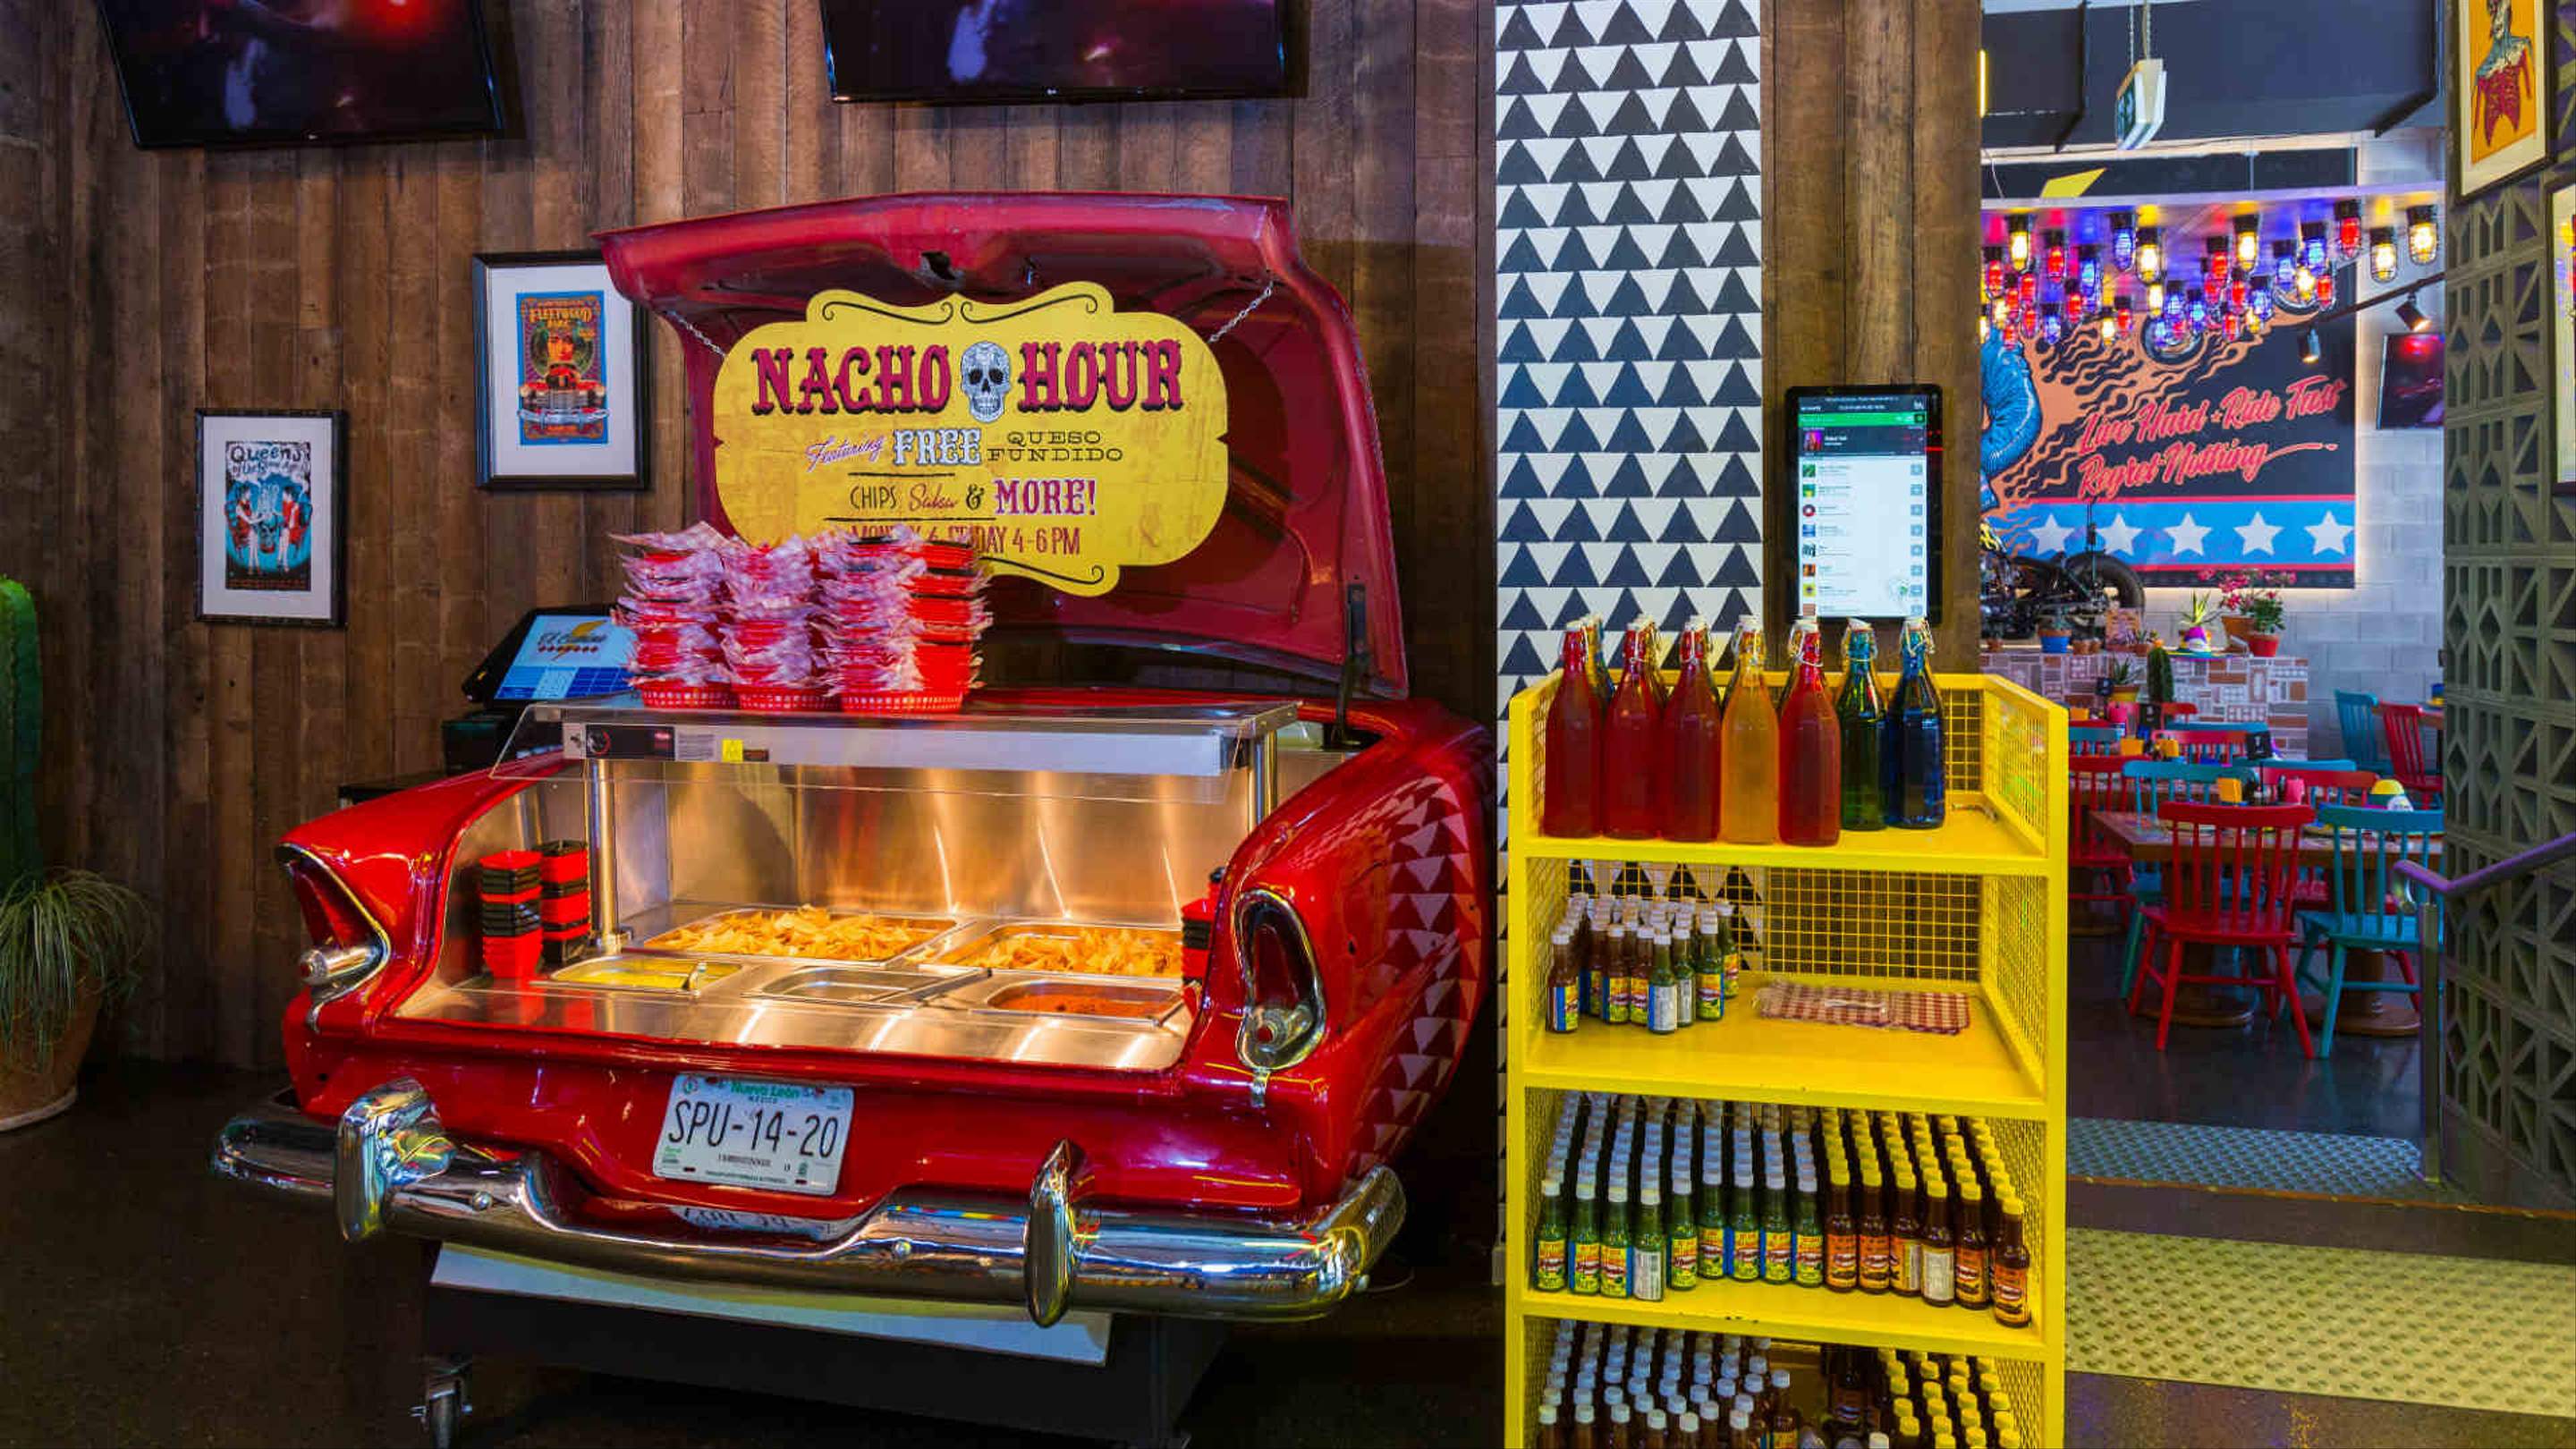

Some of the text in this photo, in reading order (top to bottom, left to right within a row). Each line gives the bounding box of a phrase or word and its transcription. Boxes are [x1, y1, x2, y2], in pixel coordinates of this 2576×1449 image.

[751, 339, 1183, 415] NACHO HOUR
[2077, 375, 2347, 456] Live Hard Ride Fast
[805, 427, 1102, 473] Featuring FREE QUESO
[987, 448, 1123, 462] FUNDIDO
[2077, 438, 2269, 499] Regret Nothing
[849, 478, 1097, 516] CHIPS Salsa & MORE!
[667, 1099, 839, 1159] SPU-14-20
